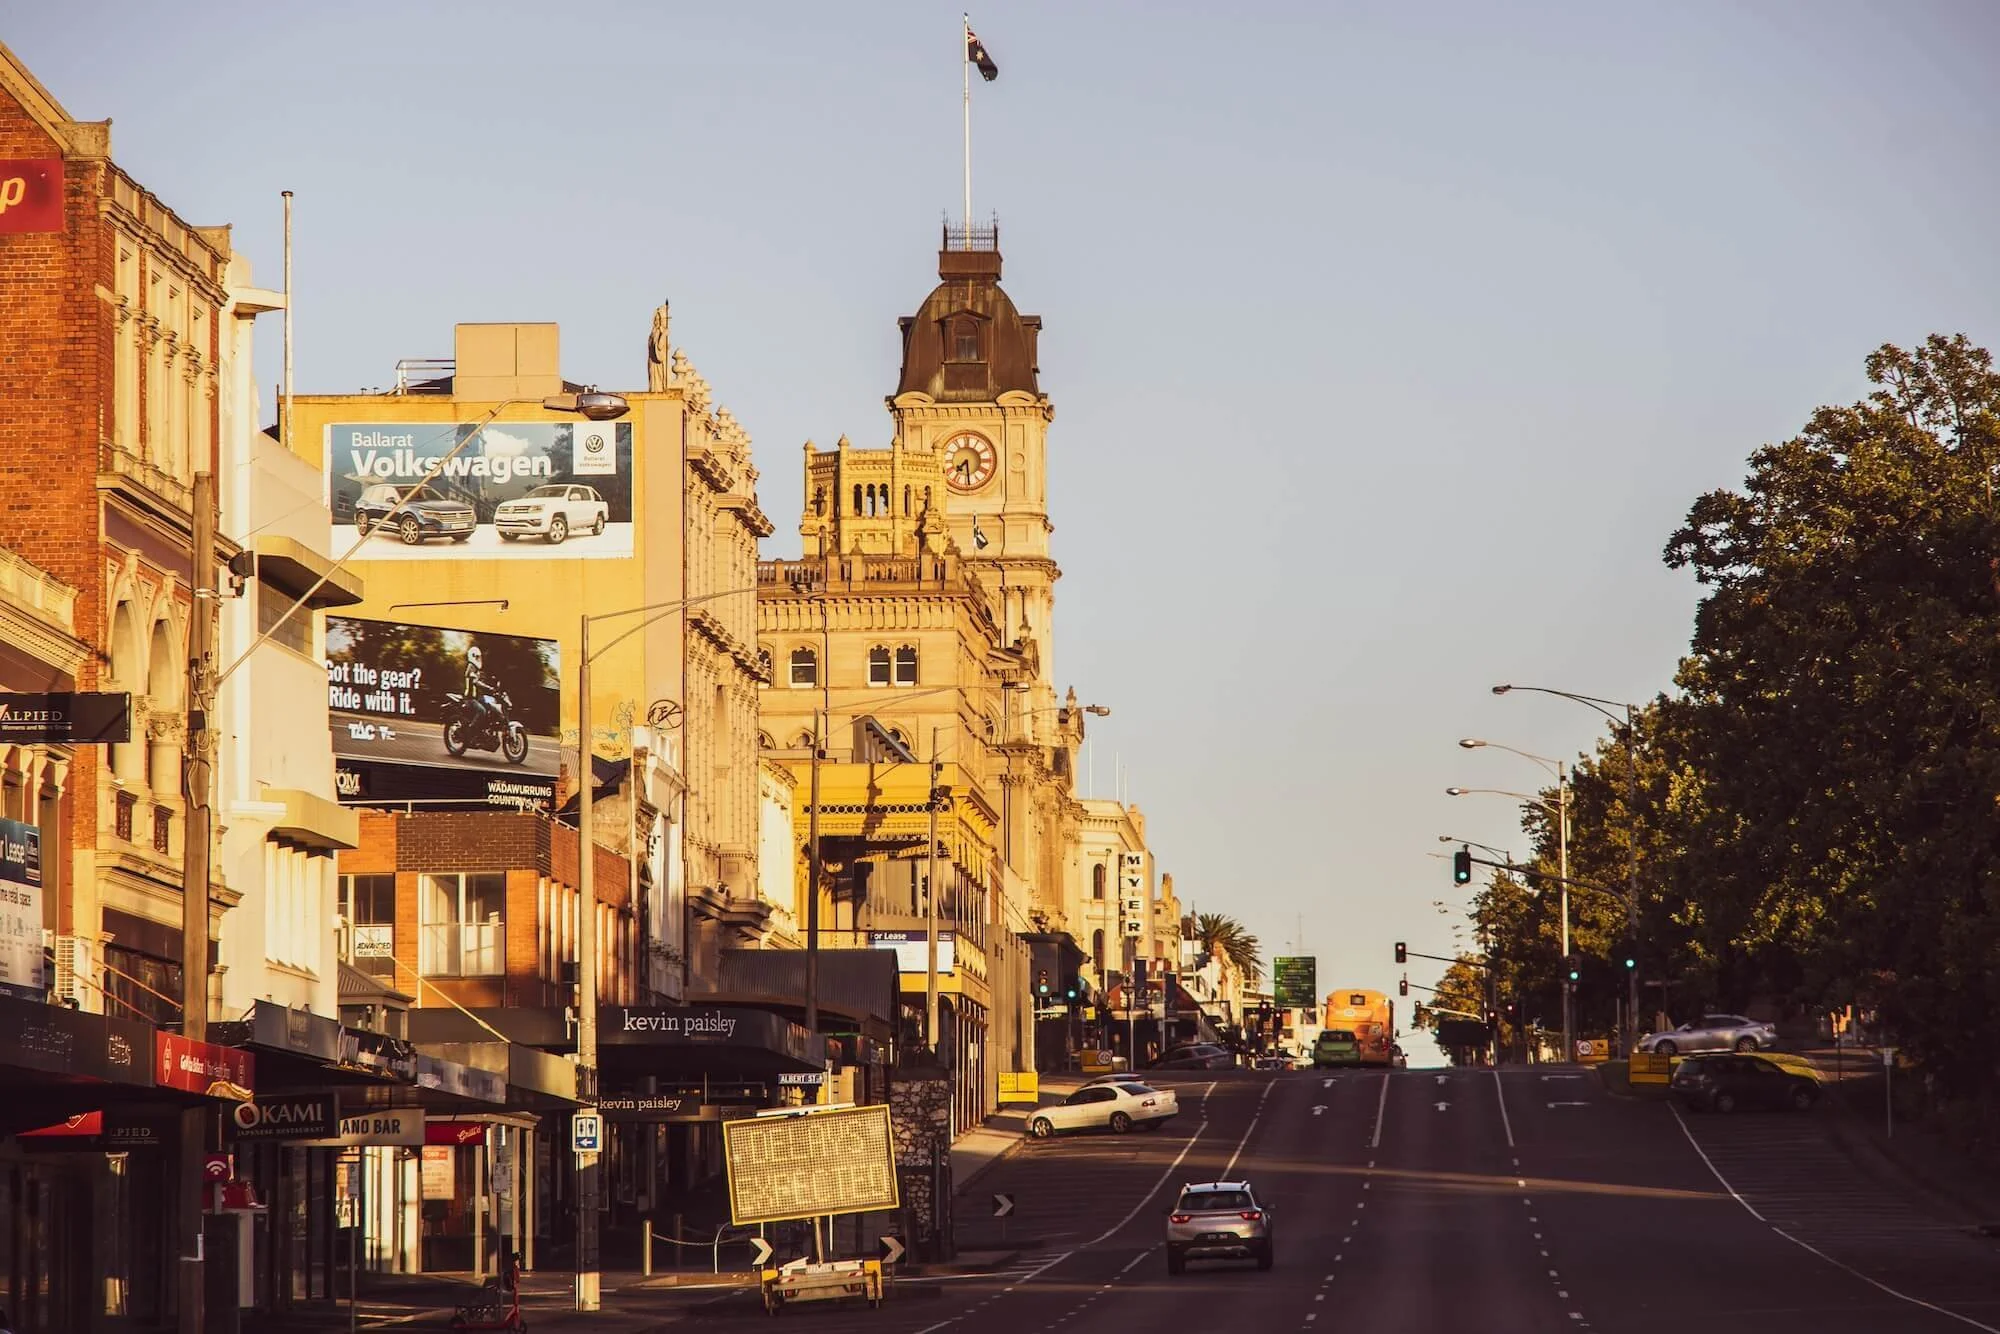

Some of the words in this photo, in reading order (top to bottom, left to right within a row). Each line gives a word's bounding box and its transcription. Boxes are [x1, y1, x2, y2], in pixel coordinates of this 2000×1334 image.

[351, 432, 413, 447] Ballarat
[351, 449, 552, 484] Volkswagen
[326, 660, 349, 683] Got
[353, 663, 377, 686] the
[380, 667, 421, 690] gear?
[329, 685, 361, 709] Ride
[365, 690, 396, 713] with
[400, 692, 416, 714] it.
[348, 721, 376, 740] TAC
[336, 772, 360, 790] OM
[488, 782, 552, 797] WADAWURRUNG
[5, 833, 25, 864] Lease
[1127, 855, 1141, 932] MYER
[884, 932, 908, 940] Lease
[623, 1009, 680, 1031] kevin
[684, 1010, 737, 1037] paisley
[780, 1074, 805, 1083] ALBERT
[807, 1074, 816, 1083] ST
[234, 1102, 324, 1129] OKAMI
[599, 1096, 635, 1110] kevin
[638, 1096, 682, 1112] paisley
[373, 1119, 401, 1134] BAR
[750, 1120, 864, 1164] DELAYS
[736, 1163, 888, 1212] EXPECTED
